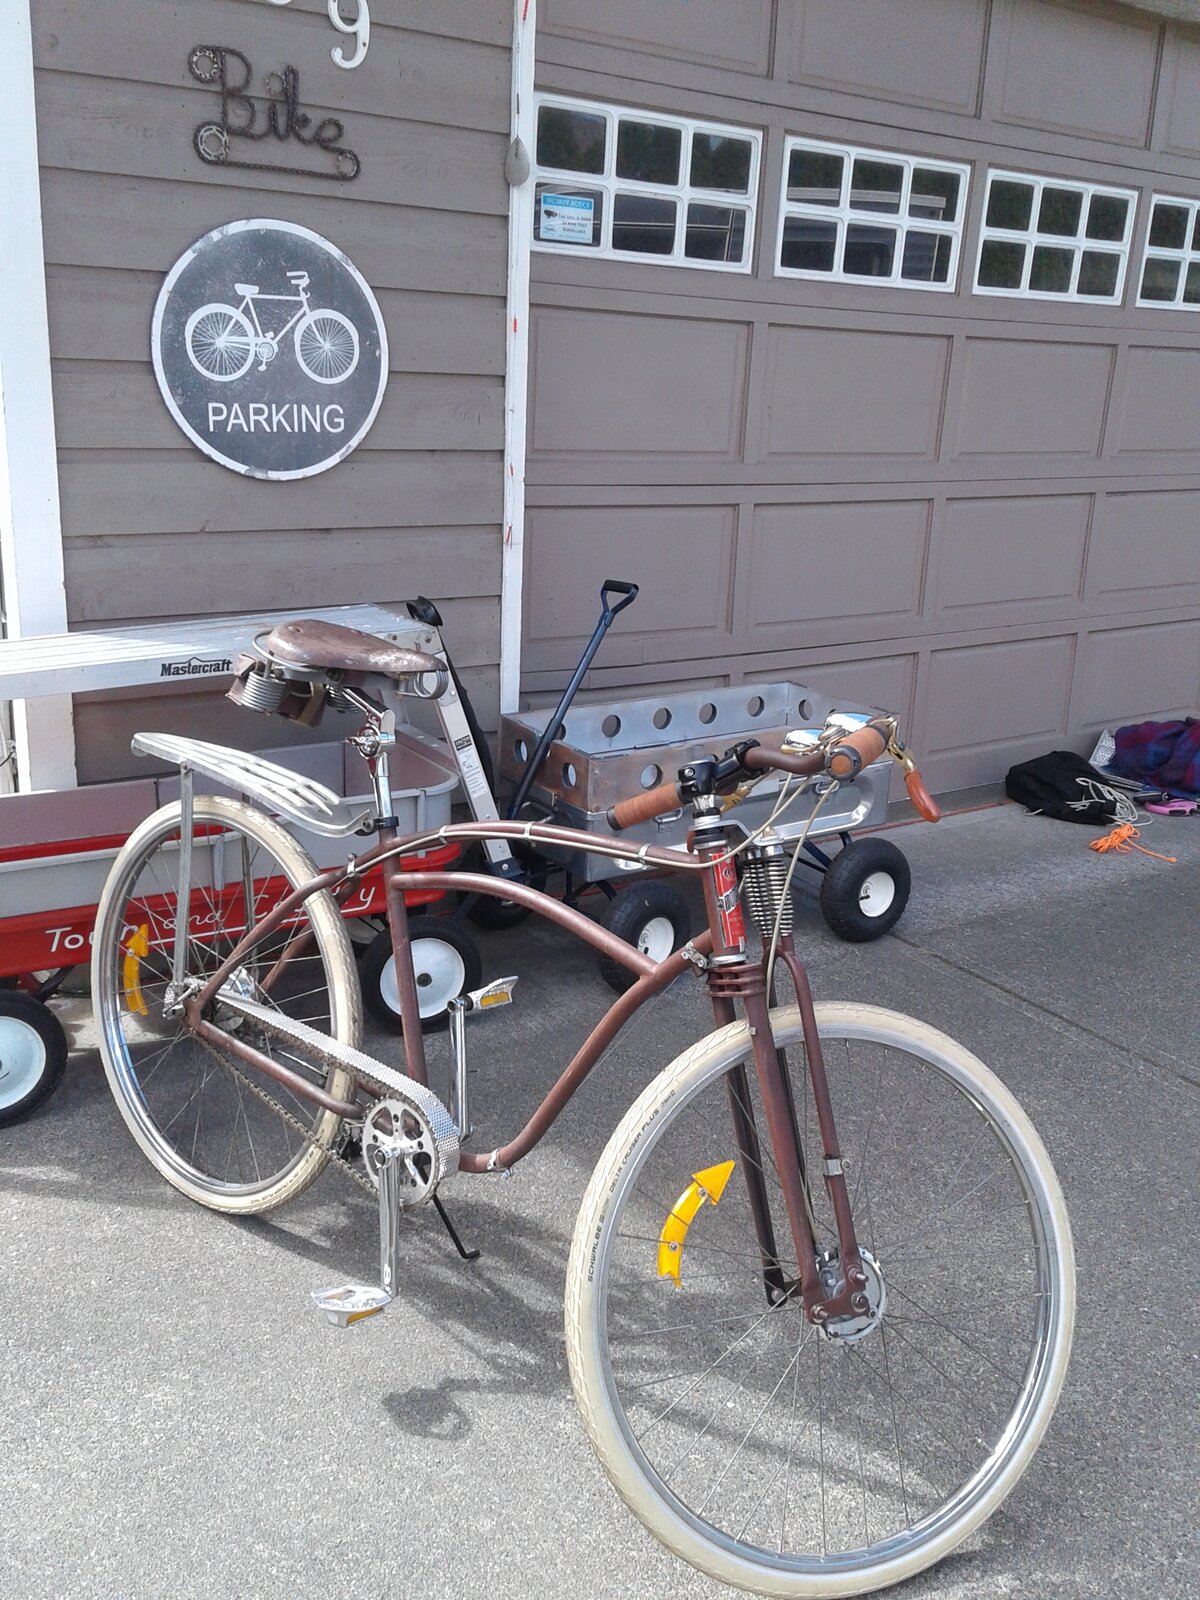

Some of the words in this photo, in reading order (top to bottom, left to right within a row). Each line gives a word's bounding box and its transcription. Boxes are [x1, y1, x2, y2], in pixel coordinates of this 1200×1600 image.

[188, 44, 344, 146] Bike
[208, 402, 345, 433] PARKING
[160, 658, 233, 676] Mastercraft
[45, 924, 141, 953] Ton
[588, 1225, 602, 1283] SCHWALBE
[609, 1166, 623, 1193] DELTA
[622, 1132, 642, 1165] CRUISER
[641, 1109, 660, 1132] PLUS
